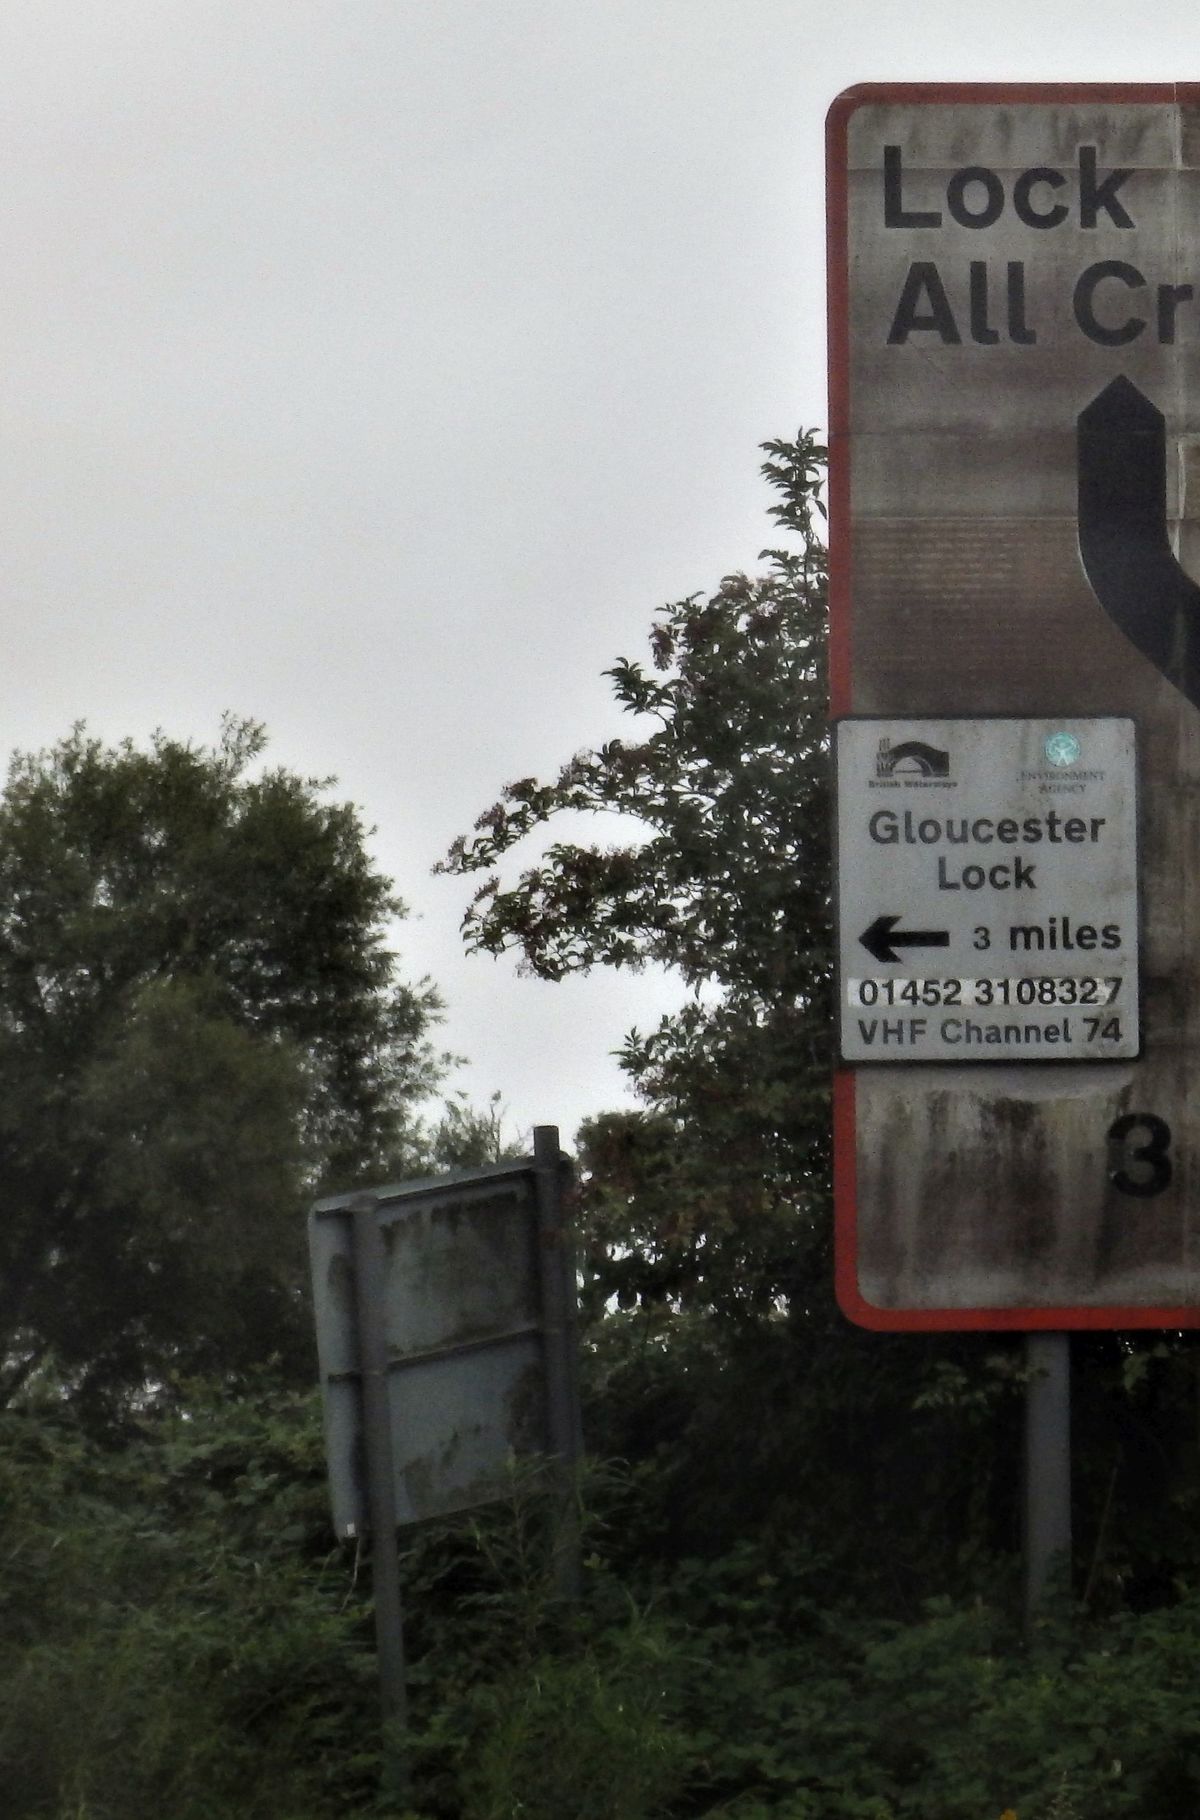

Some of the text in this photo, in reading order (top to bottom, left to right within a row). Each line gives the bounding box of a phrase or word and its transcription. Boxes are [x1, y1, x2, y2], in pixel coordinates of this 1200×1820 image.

[883, 146, 1136, 229] Lock
[886, 261, 1036, 345] All
[868, 811, 1106, 844] Gloucester
[938, 856, 1037, 890] Lock
[973, 917, 1122, 950] 3 miles
[859, 979, 962, 1006] 01452
[858, 1017, 1123, 1046] VHF Channel 74
[1107, 1112, 1172, 1196] 3
